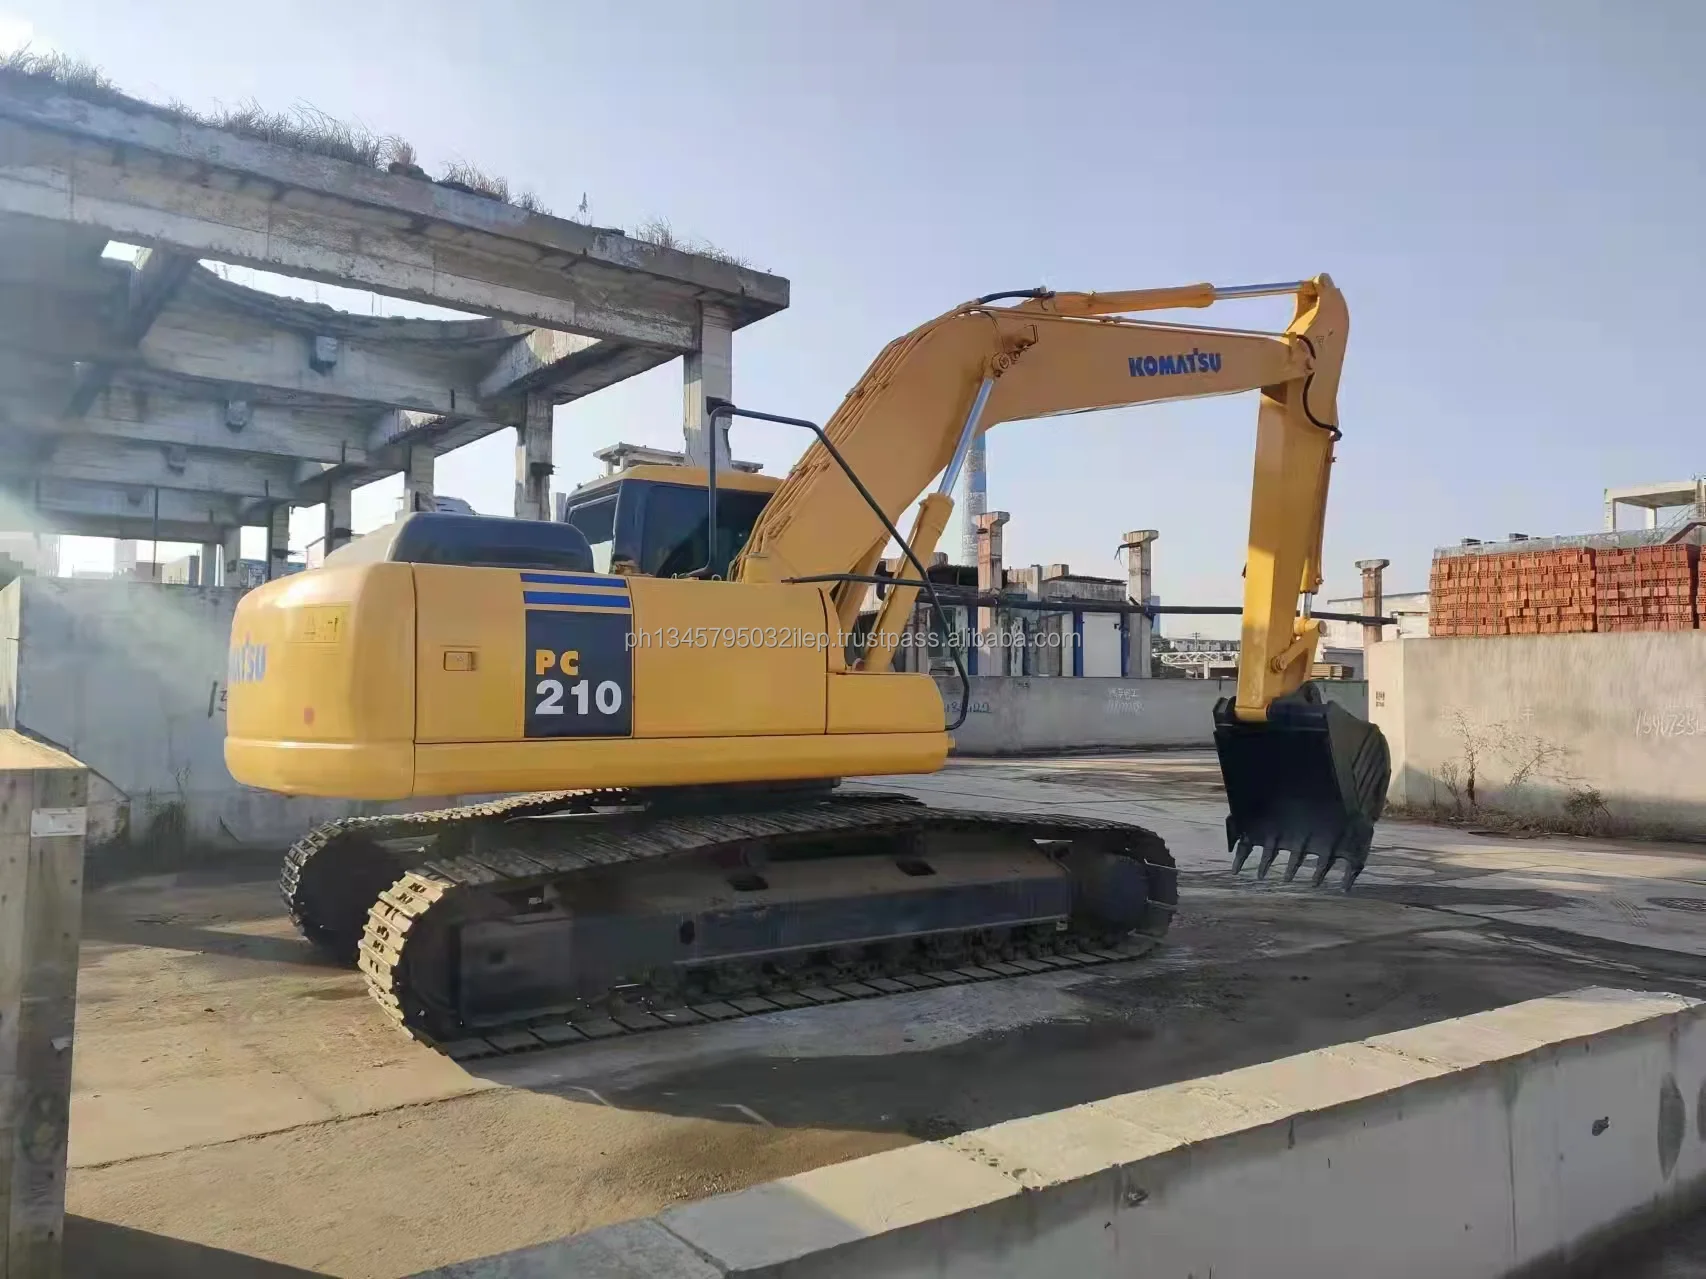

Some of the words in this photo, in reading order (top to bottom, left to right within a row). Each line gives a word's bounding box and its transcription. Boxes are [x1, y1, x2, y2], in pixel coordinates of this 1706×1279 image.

[1128, 348, 1221, 377] KOMATSU
[535, 649, 579, 676] PC
[535, 679, 622, 715] 210
